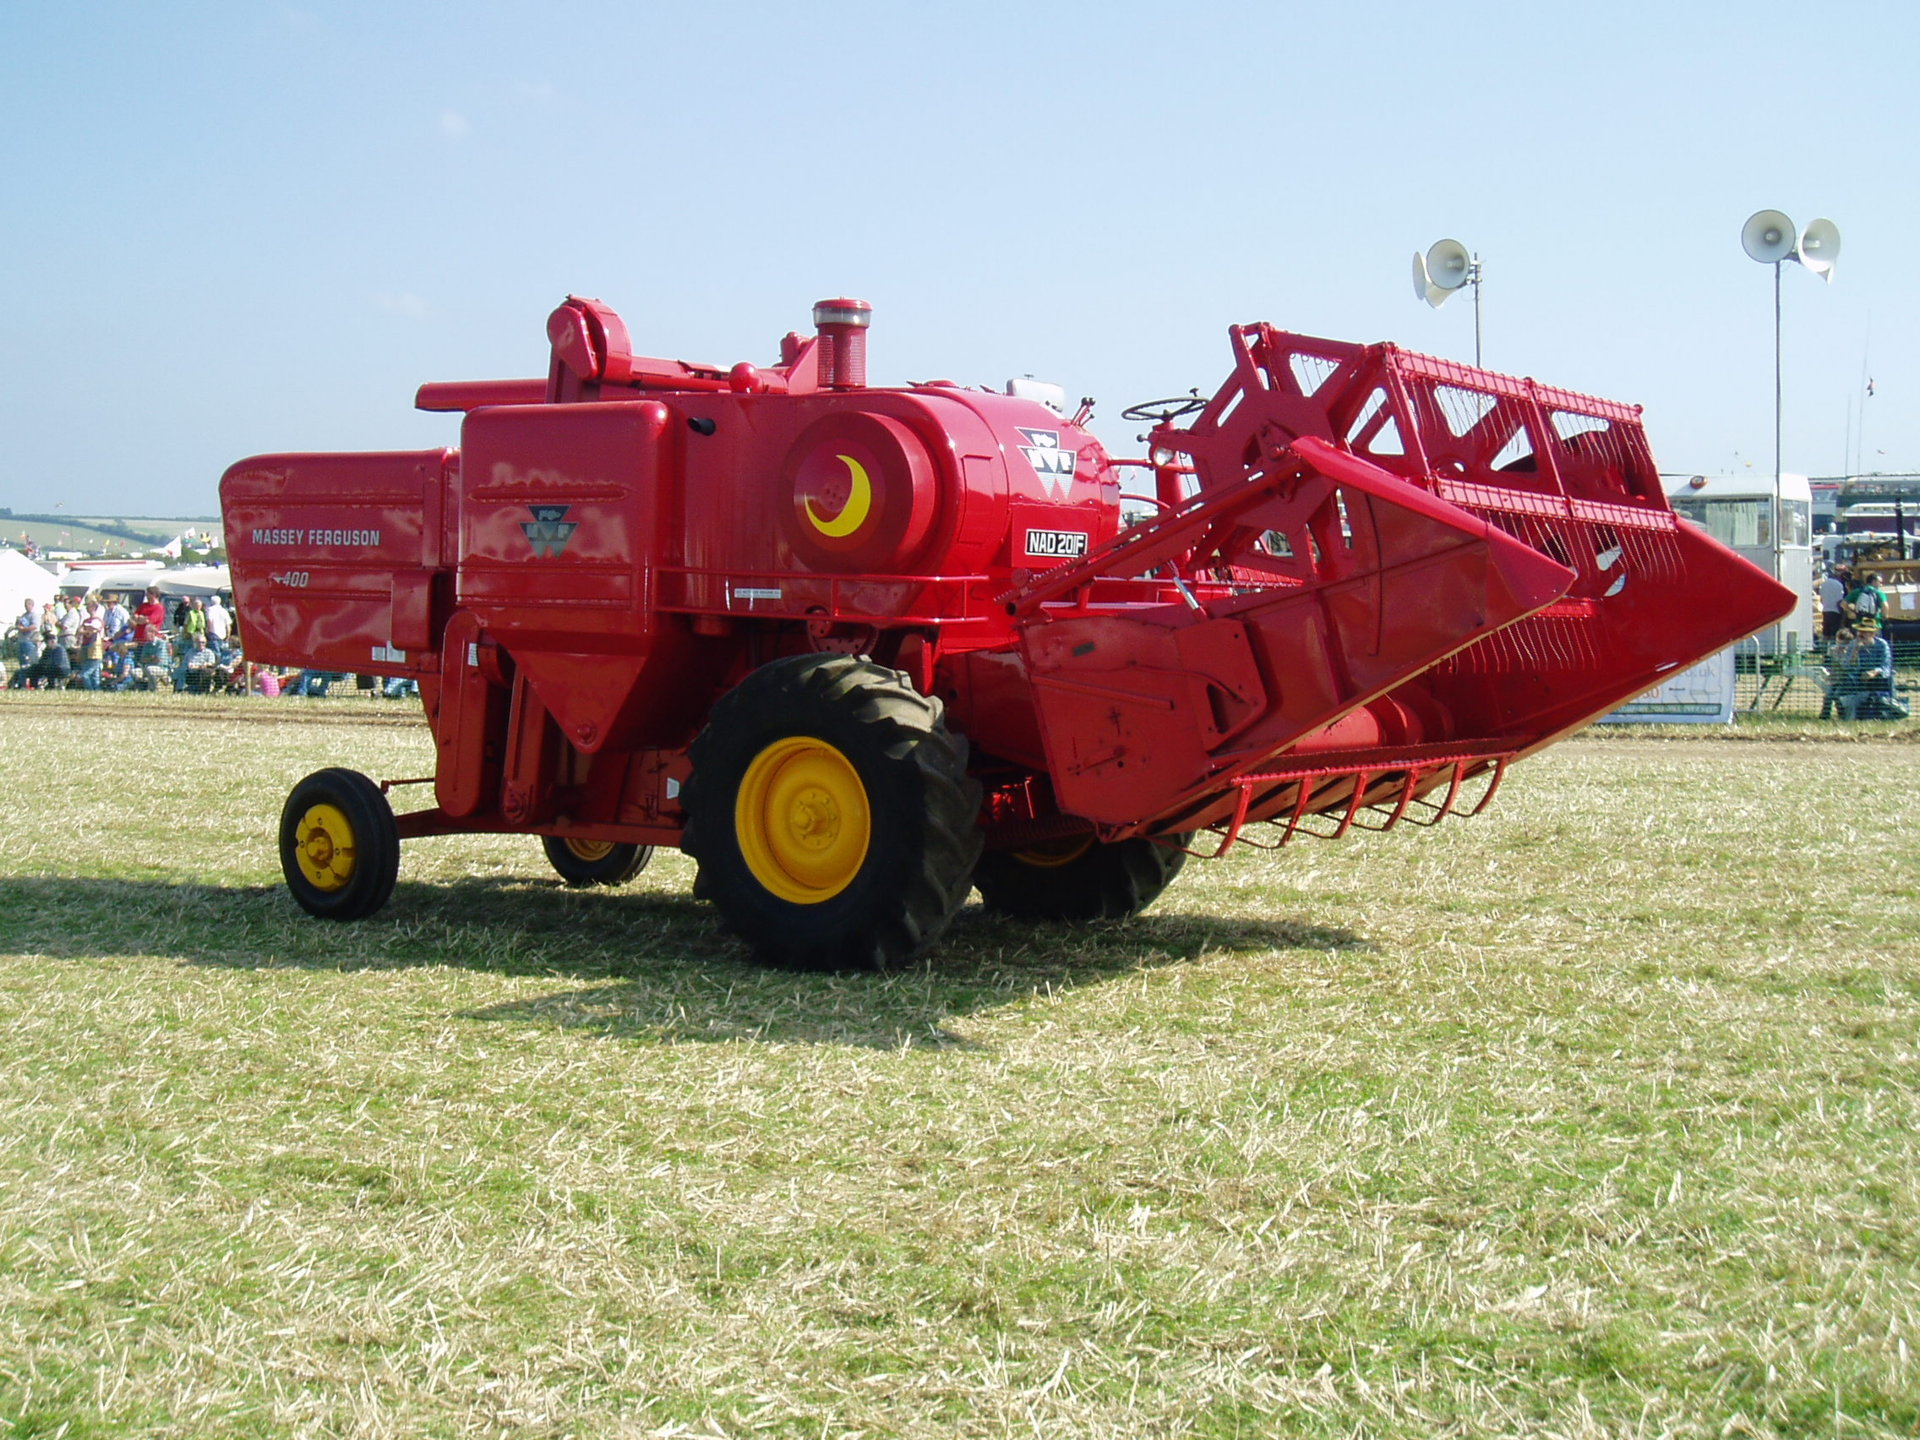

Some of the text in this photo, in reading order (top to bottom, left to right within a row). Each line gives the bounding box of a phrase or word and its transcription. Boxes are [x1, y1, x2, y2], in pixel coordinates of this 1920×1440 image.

[252, 529, 380, 546] MASSEY FERGUSON
[1029, 532, 1084, 555] NAD 201F
[282, 571, 309, 588] 400
